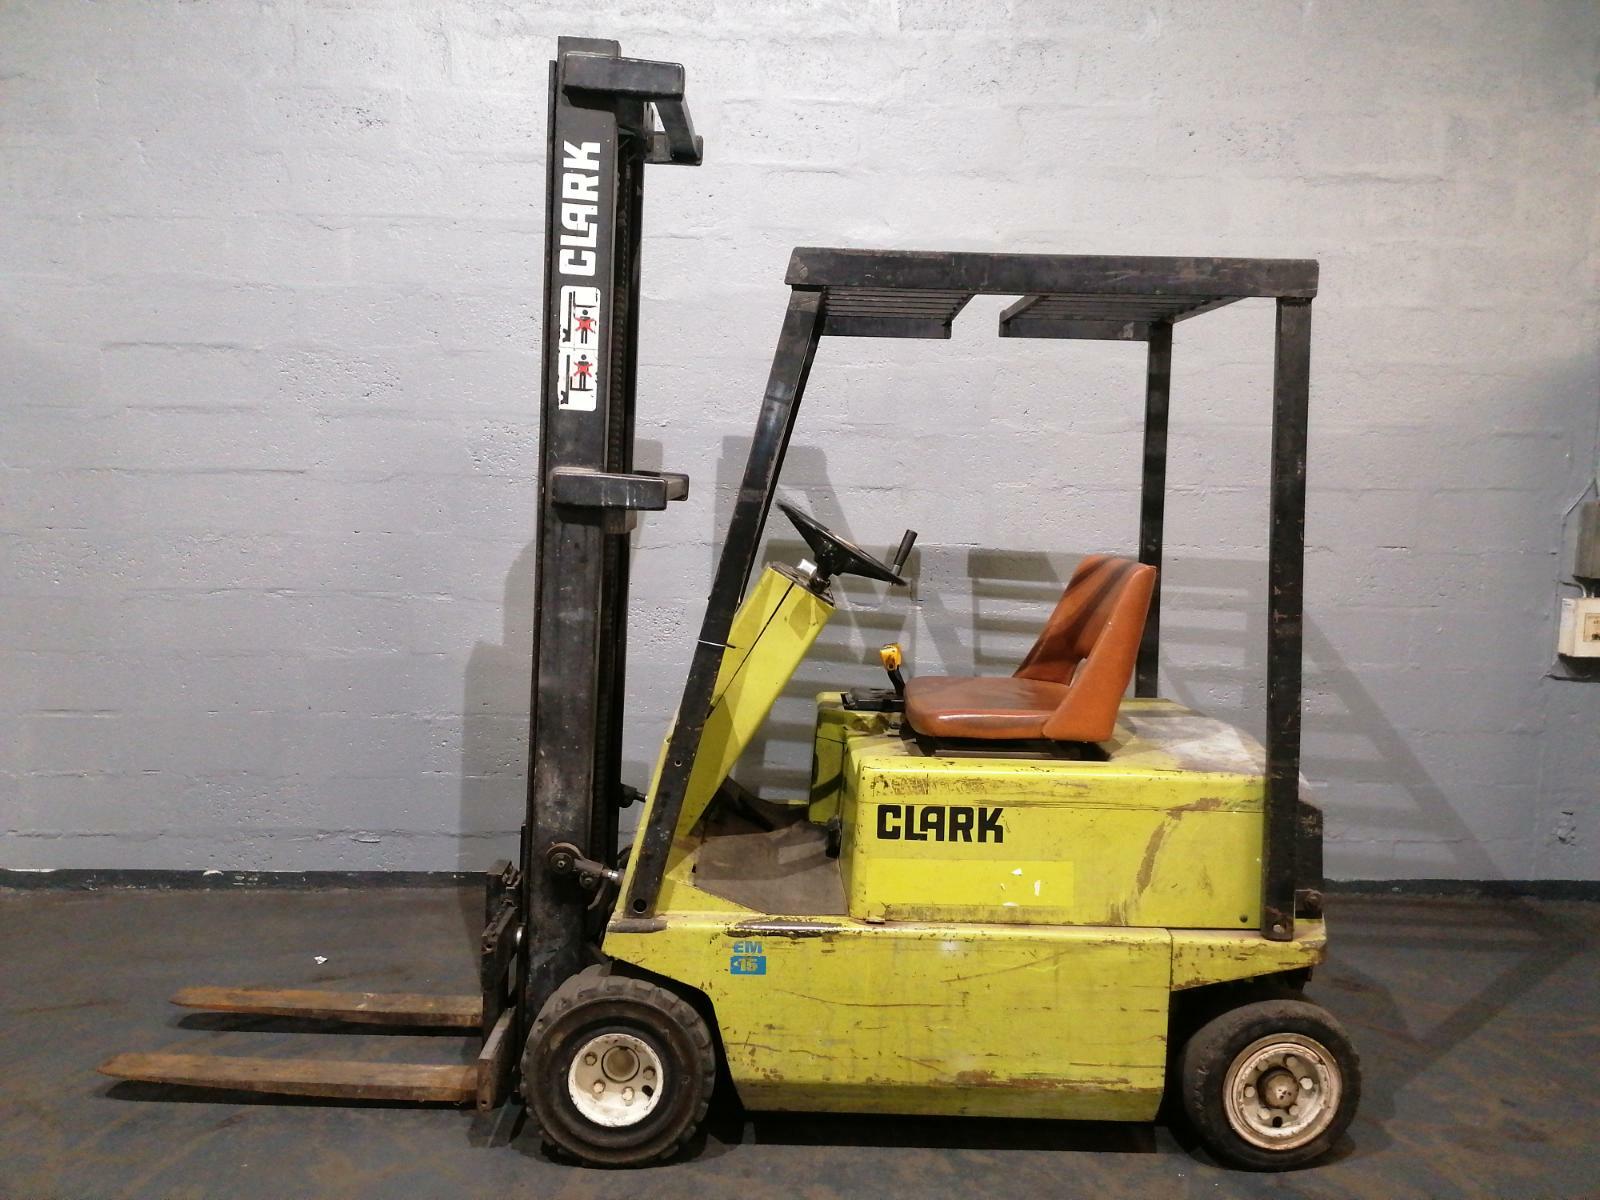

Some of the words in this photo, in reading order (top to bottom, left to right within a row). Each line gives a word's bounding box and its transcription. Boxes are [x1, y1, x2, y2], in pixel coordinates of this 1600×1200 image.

[559, 140, 600, 276] CLARK
[877, 804, 1003, 843] CLARK
[733, 941, 762, 953] EM
